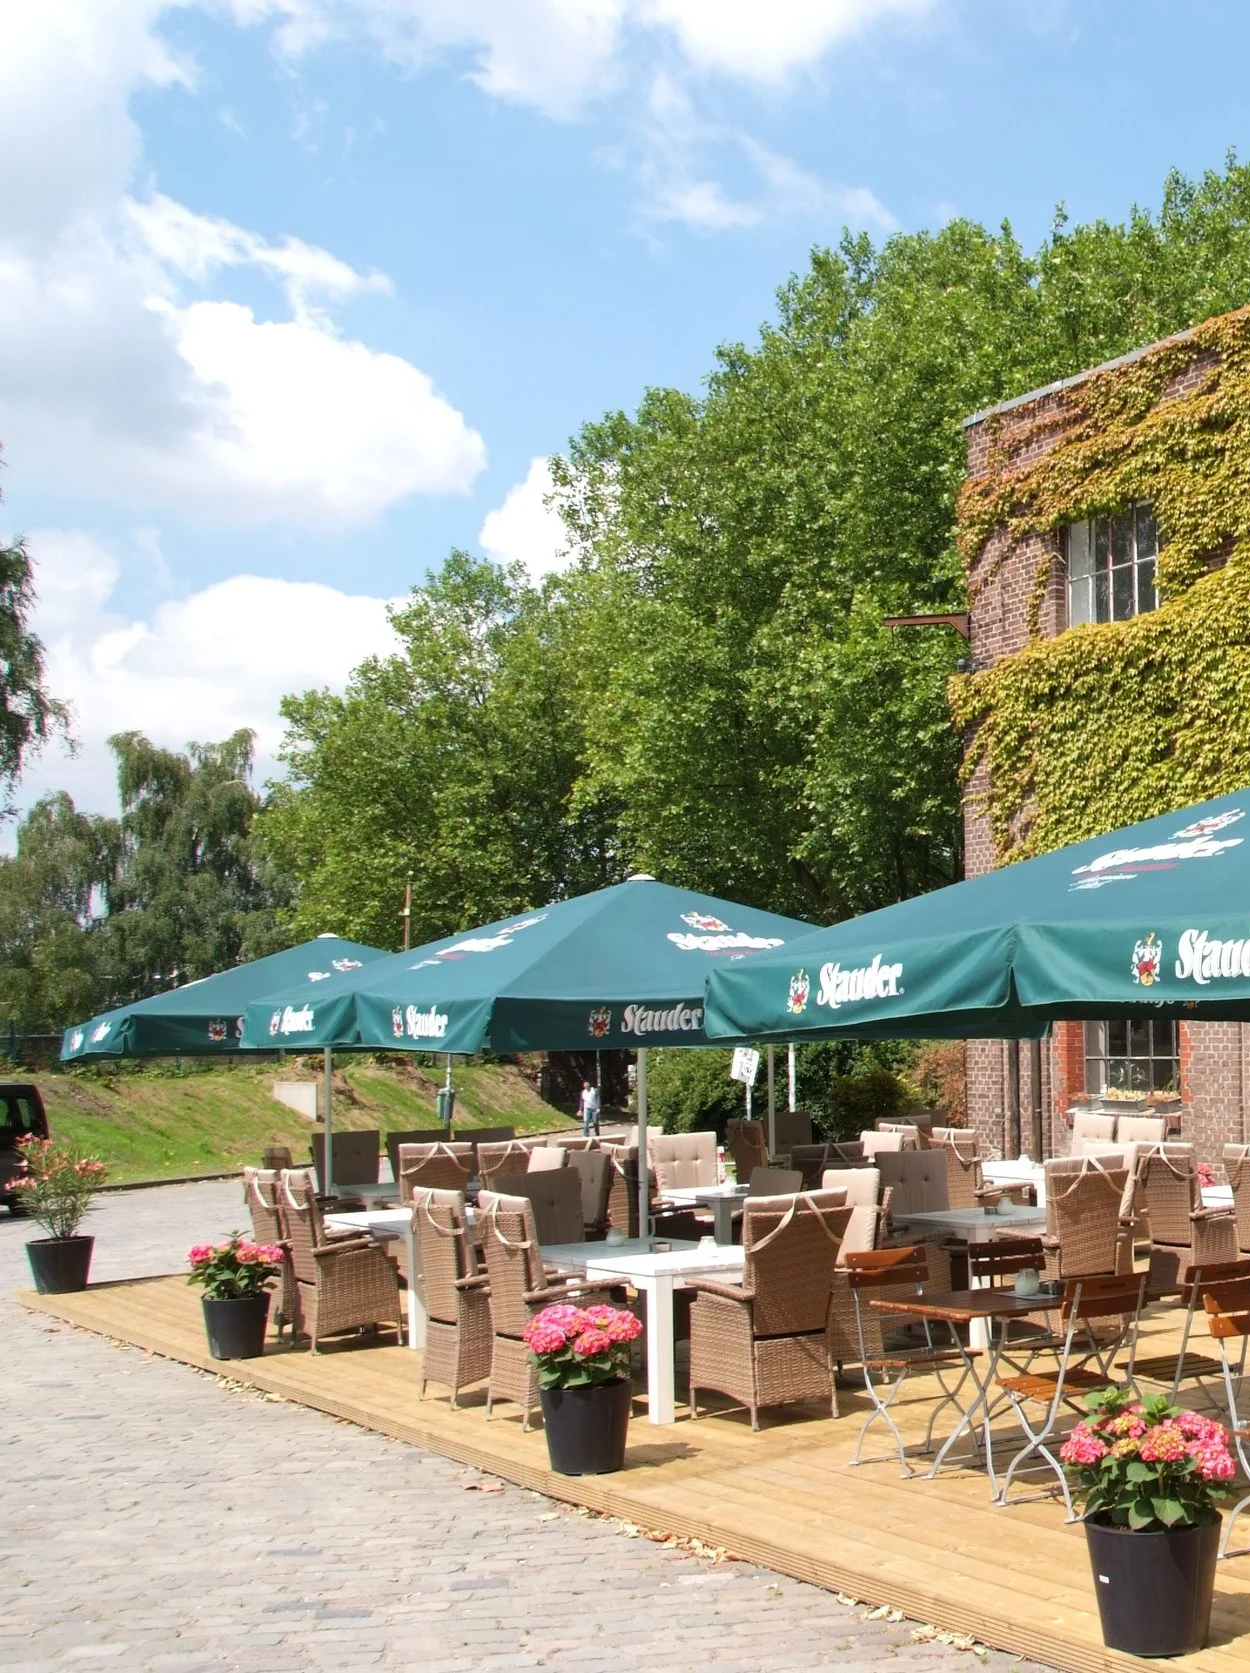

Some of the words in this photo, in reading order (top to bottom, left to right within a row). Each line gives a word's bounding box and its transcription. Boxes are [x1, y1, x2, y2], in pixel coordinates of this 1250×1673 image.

[817, 953, 903, 1009] Stauder
[406, 1004, 448, 1040] Stauder
[621, 1002, 703, 1036] Stauder
